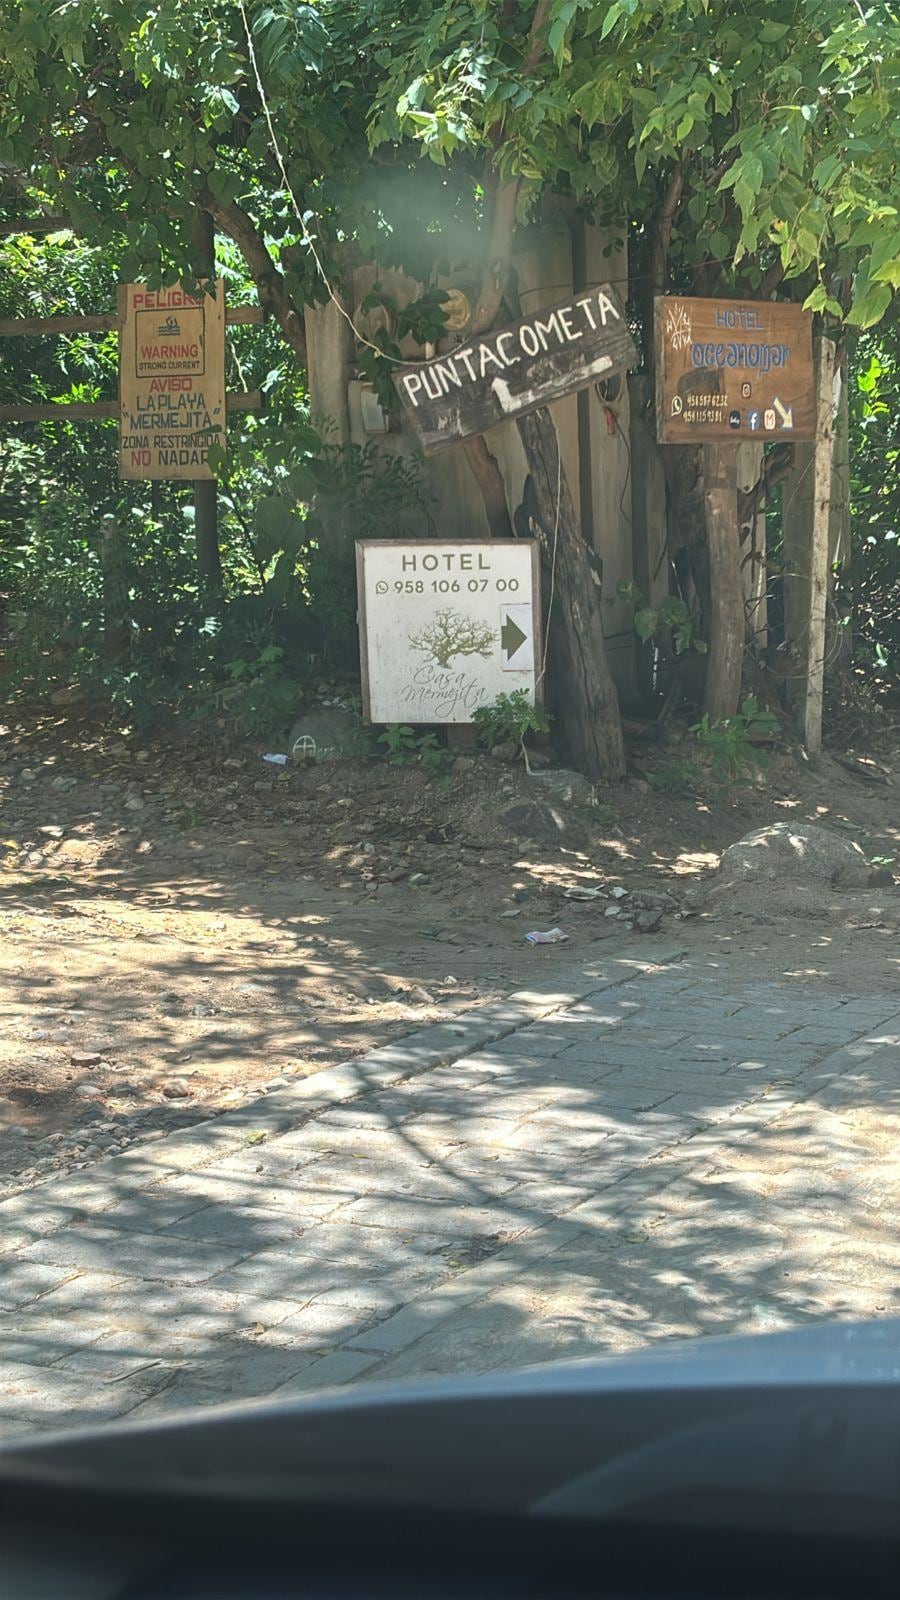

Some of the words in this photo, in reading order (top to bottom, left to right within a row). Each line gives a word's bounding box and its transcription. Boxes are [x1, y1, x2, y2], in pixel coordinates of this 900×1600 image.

[715, 309, 765, 330] HOTEL
[141, 344, 199, 359] WARNING
[139, 362, 167, 371] STRONG
[168, 360, 200, 370] CURRENT
[150, 378, 193, 393] AVISO
[122, 435, 149, 449] ZONA
[153, 433, 220, 449] RESTRINGIDA
[131, 450, 152, 467] NO
[402, 553, 491, 571] HOTEL
[394, 580, 424, 593] 958
[431, 580, 460, 593] 106
[467, 579, 488, 592] 07
[495, 578, 519, 591] 00
[414, 665, 466, 690] Casa
[401, 679, 489, 718] Mermejita
